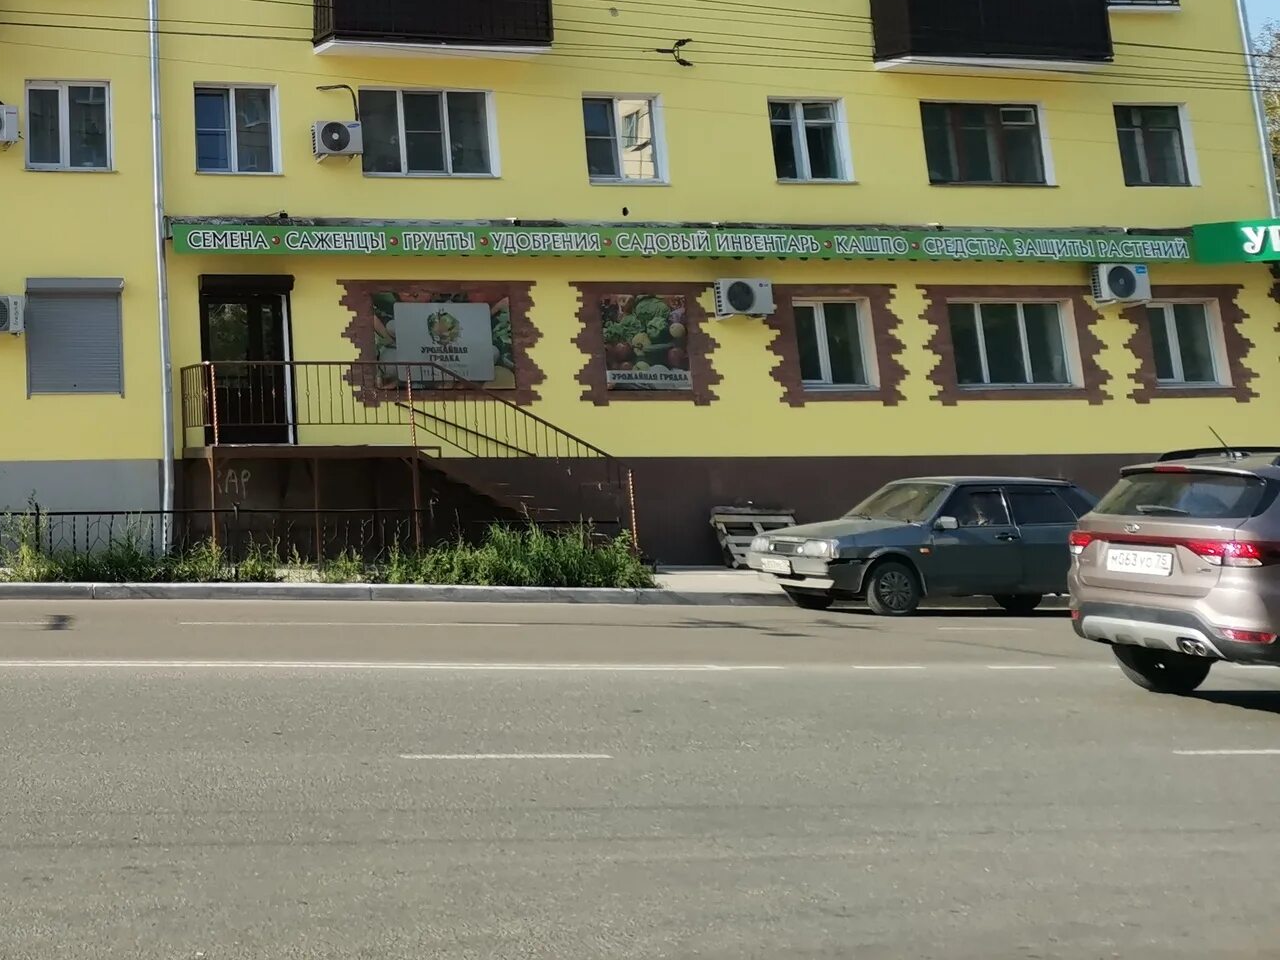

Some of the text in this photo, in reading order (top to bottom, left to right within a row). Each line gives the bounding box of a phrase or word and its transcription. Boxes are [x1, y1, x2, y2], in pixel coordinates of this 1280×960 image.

[187, 230, 1190, 260] СЕМЕНА САЖЕНЦЫ ГРУНТЫ УДОБРЕНИЯ САДОВЫЙ ИНВЕНТАРЬ КАШПО СРЕДСТВА ЗАЩИТЫ РАСТЕНИЙ
